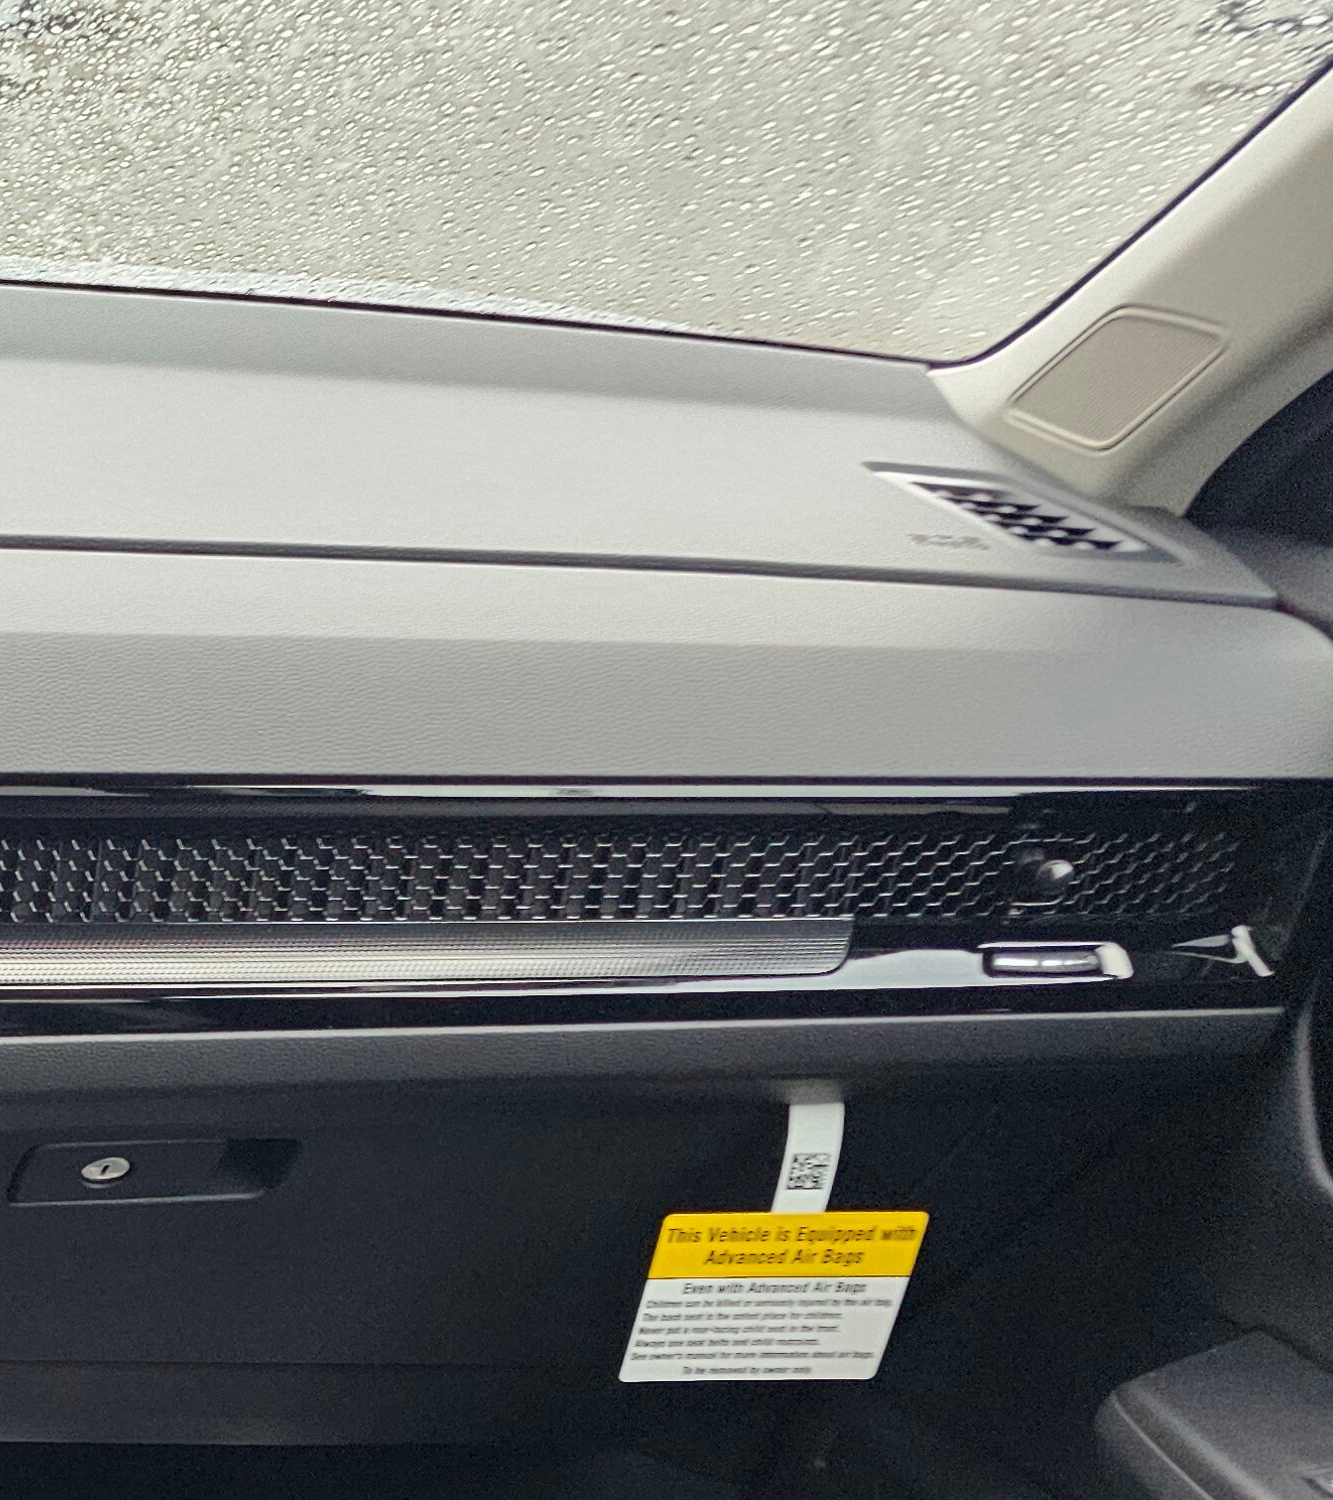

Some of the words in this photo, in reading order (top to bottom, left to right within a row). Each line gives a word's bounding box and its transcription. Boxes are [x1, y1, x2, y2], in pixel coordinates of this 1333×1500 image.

[667, 1228, 701, 1243] This
[708, 1227, 770, 1243] Vehicle
[776, 1227, 791, 1242] is
[795, 1226, 876, 1246] Equipped
[881, 1226, 918, 1241] with
[703, 1249, 786, 1265] Advanced
[793, 1249, 817, 1264] Air
[823, 1249, 866, 1267] Bags
[683, 1283, 712, 1295] Even
[717, 1283, 746, 1294] with
[749, 1282, 810, 1294] Advanced
[813, 1282, 833, 1294] Air
[836, 1282, 867, 1296] Bags
